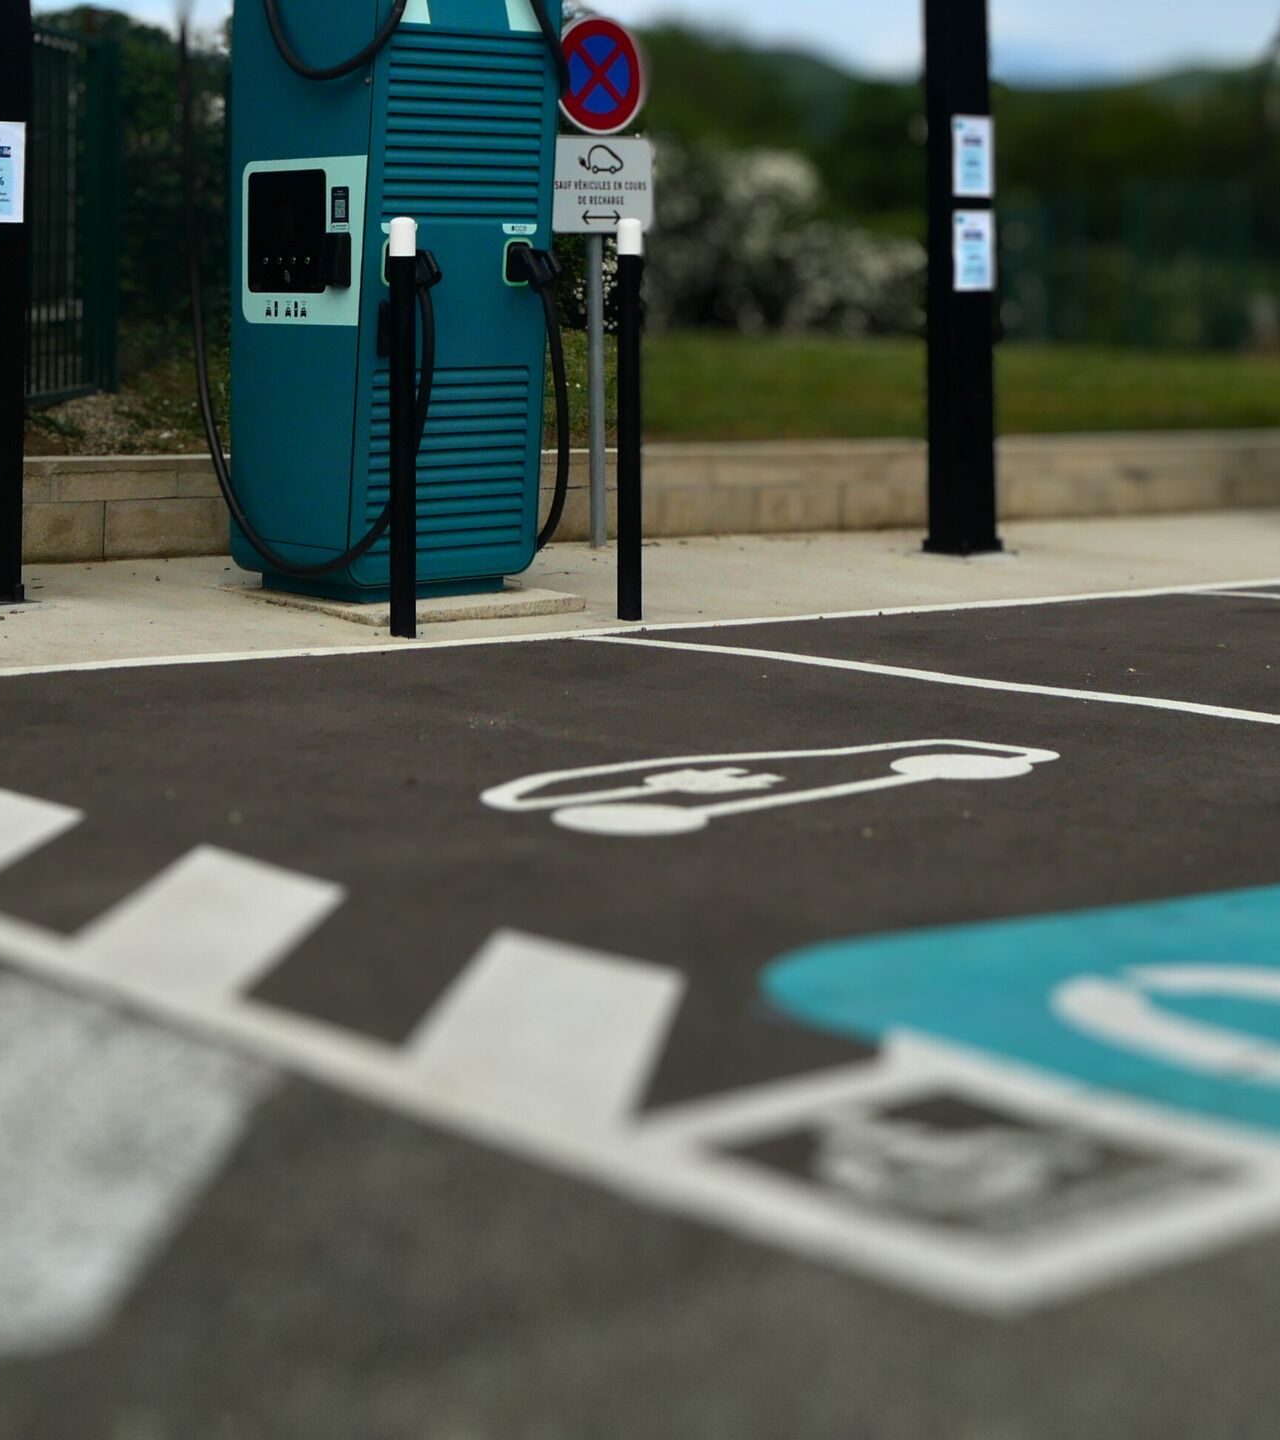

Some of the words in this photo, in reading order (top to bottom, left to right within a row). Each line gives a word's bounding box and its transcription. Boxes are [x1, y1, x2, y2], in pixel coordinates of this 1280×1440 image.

[555, 180, 572, 190] SAUF
[574, 179, 611, 190] VÉHICULES
[613, 180, 623, 191] EN
[624, 181, 647, 191] COURS
[578, 195, 587, 205] DE
[589, 195, 625, 205] RECHARGE
